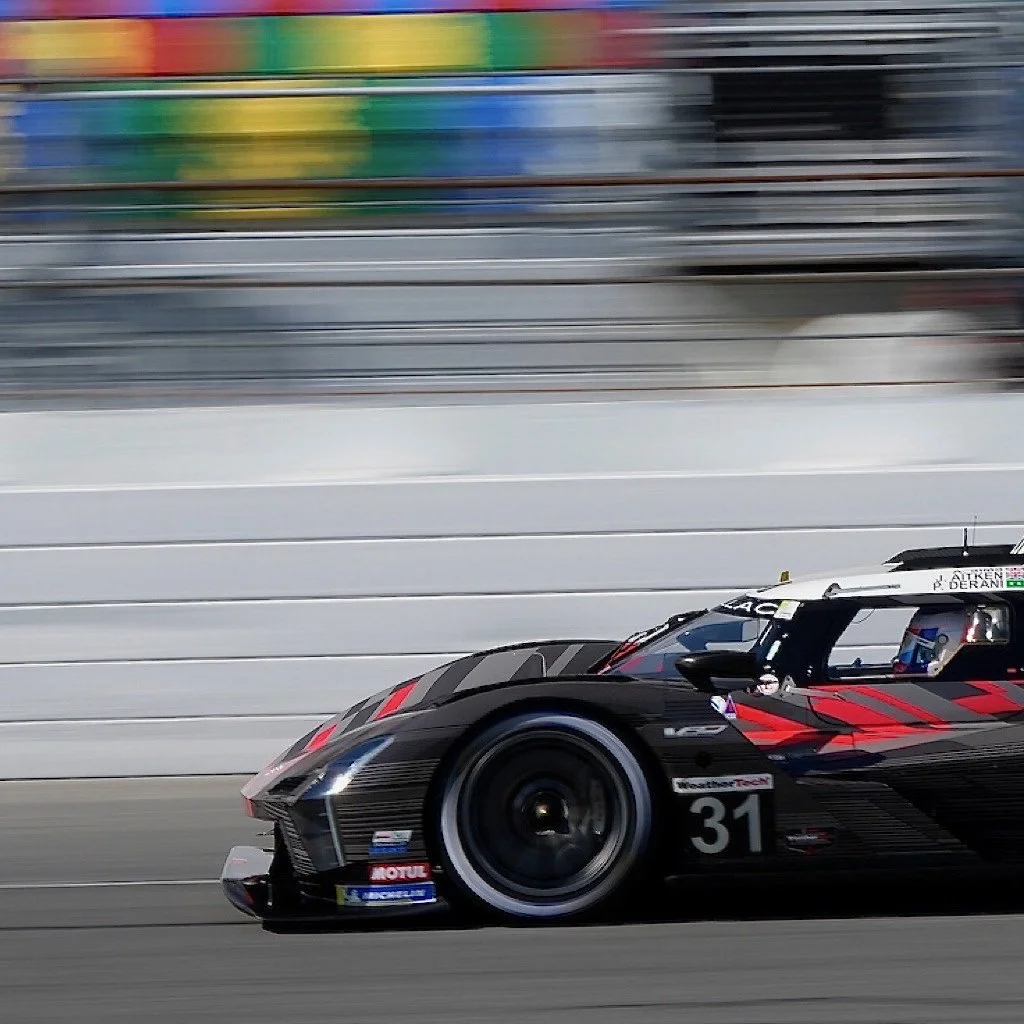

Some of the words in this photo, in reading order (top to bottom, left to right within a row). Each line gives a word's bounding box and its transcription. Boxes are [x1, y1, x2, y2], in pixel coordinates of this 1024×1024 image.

[951, 571, 1003, 582] AITKEN
[949, 580, 1004, 590] DERANI
[689, 794, 762, 854] 31
[371, 865, 428, 880] MOTUL
